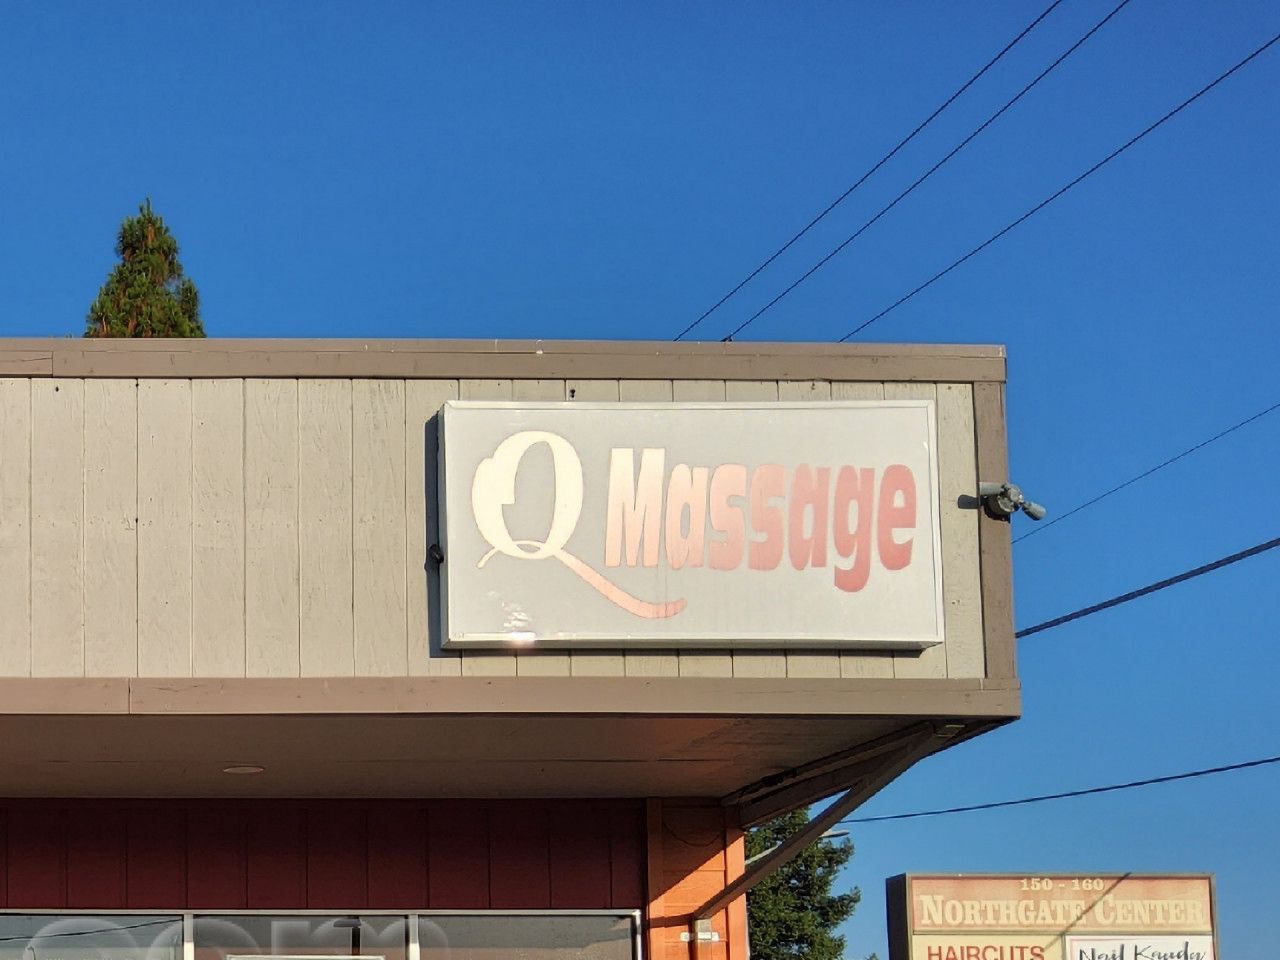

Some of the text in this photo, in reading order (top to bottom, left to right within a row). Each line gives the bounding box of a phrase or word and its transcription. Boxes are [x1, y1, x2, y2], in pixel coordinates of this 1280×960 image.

[471, 430, 917, 619] Q Massage
[1020, 878, 1053, 891] 150
[1070, 878, 1104, 891] 160
[919, 893, 1204, 926] NORTHGATE CENTER
